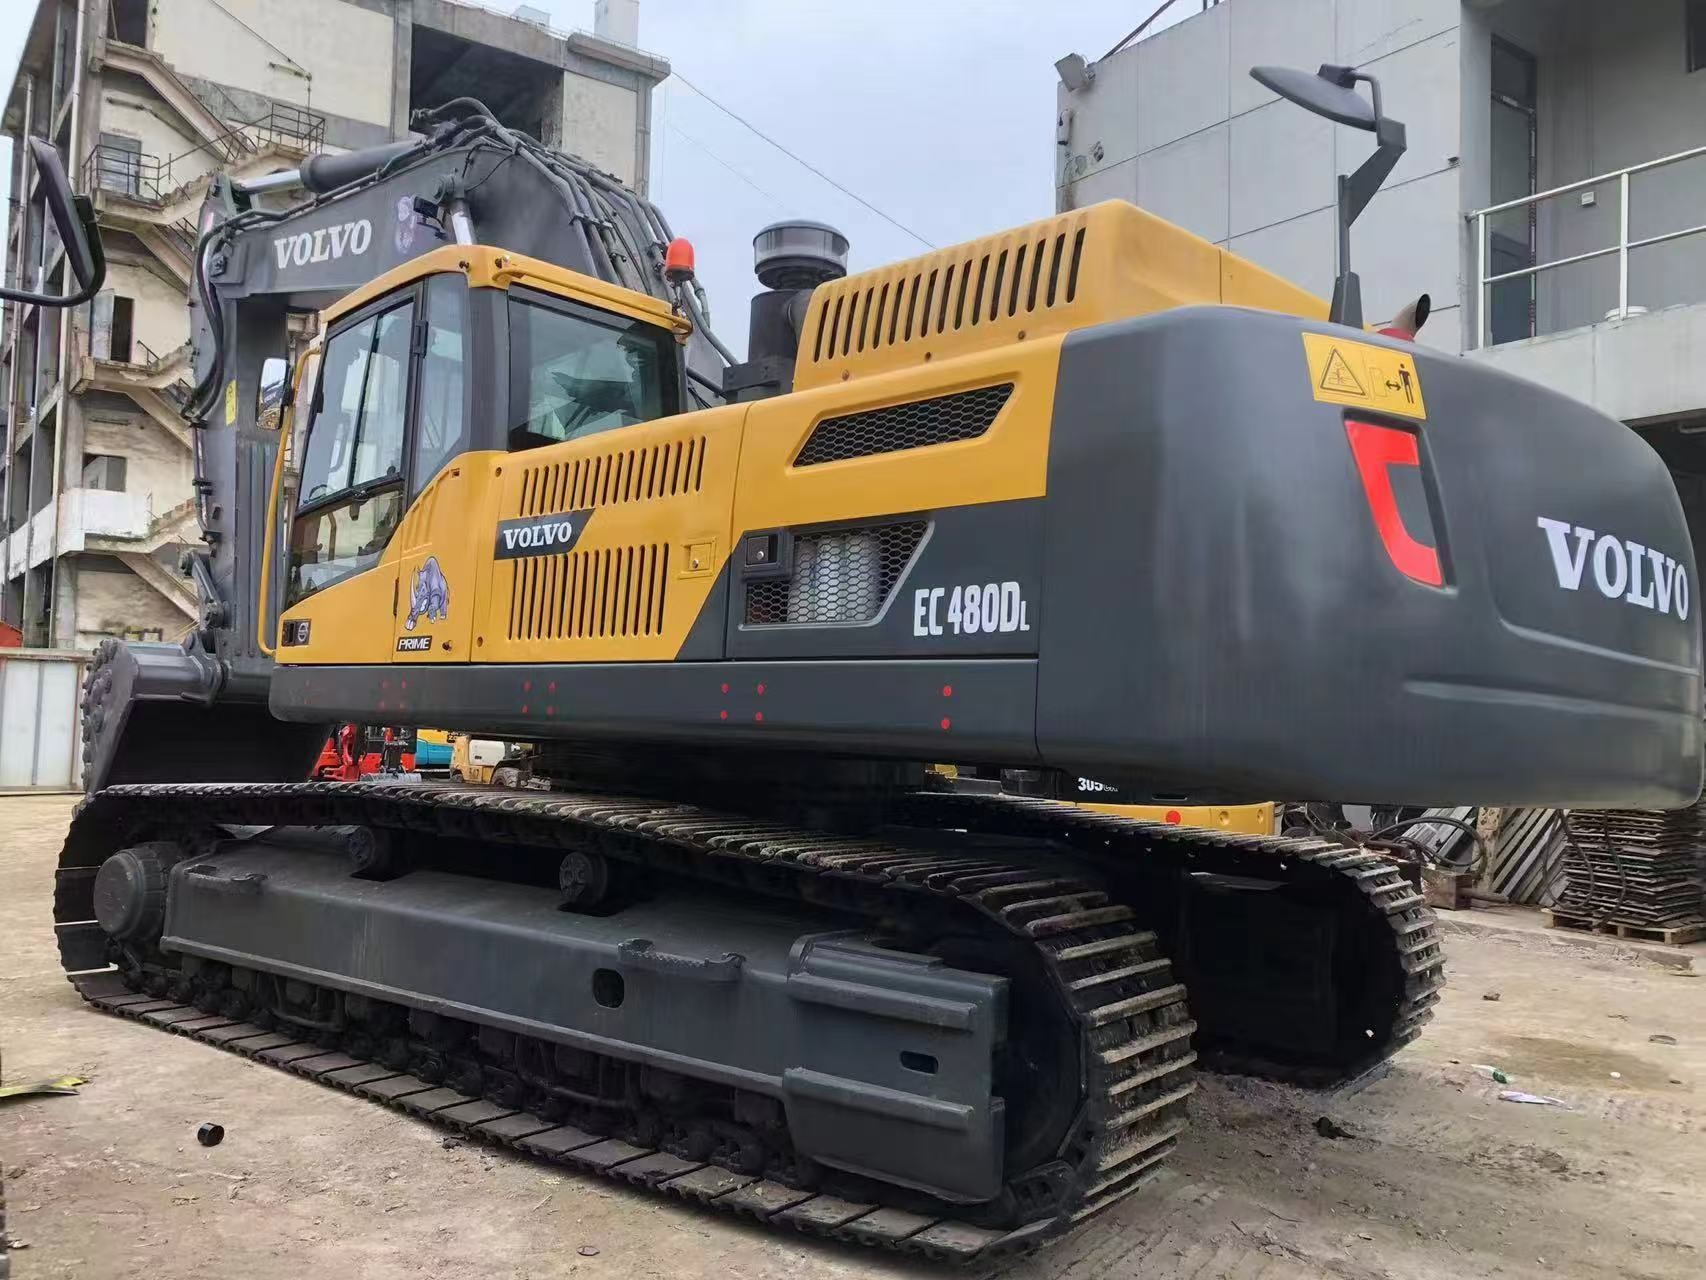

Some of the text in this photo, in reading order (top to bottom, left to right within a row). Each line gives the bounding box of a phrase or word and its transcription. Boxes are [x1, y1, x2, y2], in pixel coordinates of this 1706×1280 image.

[274, 219, 372, 269] VOLVO
[503, 521, 572, 550] VOLVO
[1537, 516, 1689, 620] VOLVO
[914, 581, 1030, 636] EC 480DL
[398, 637, 431, 650] PRIME
